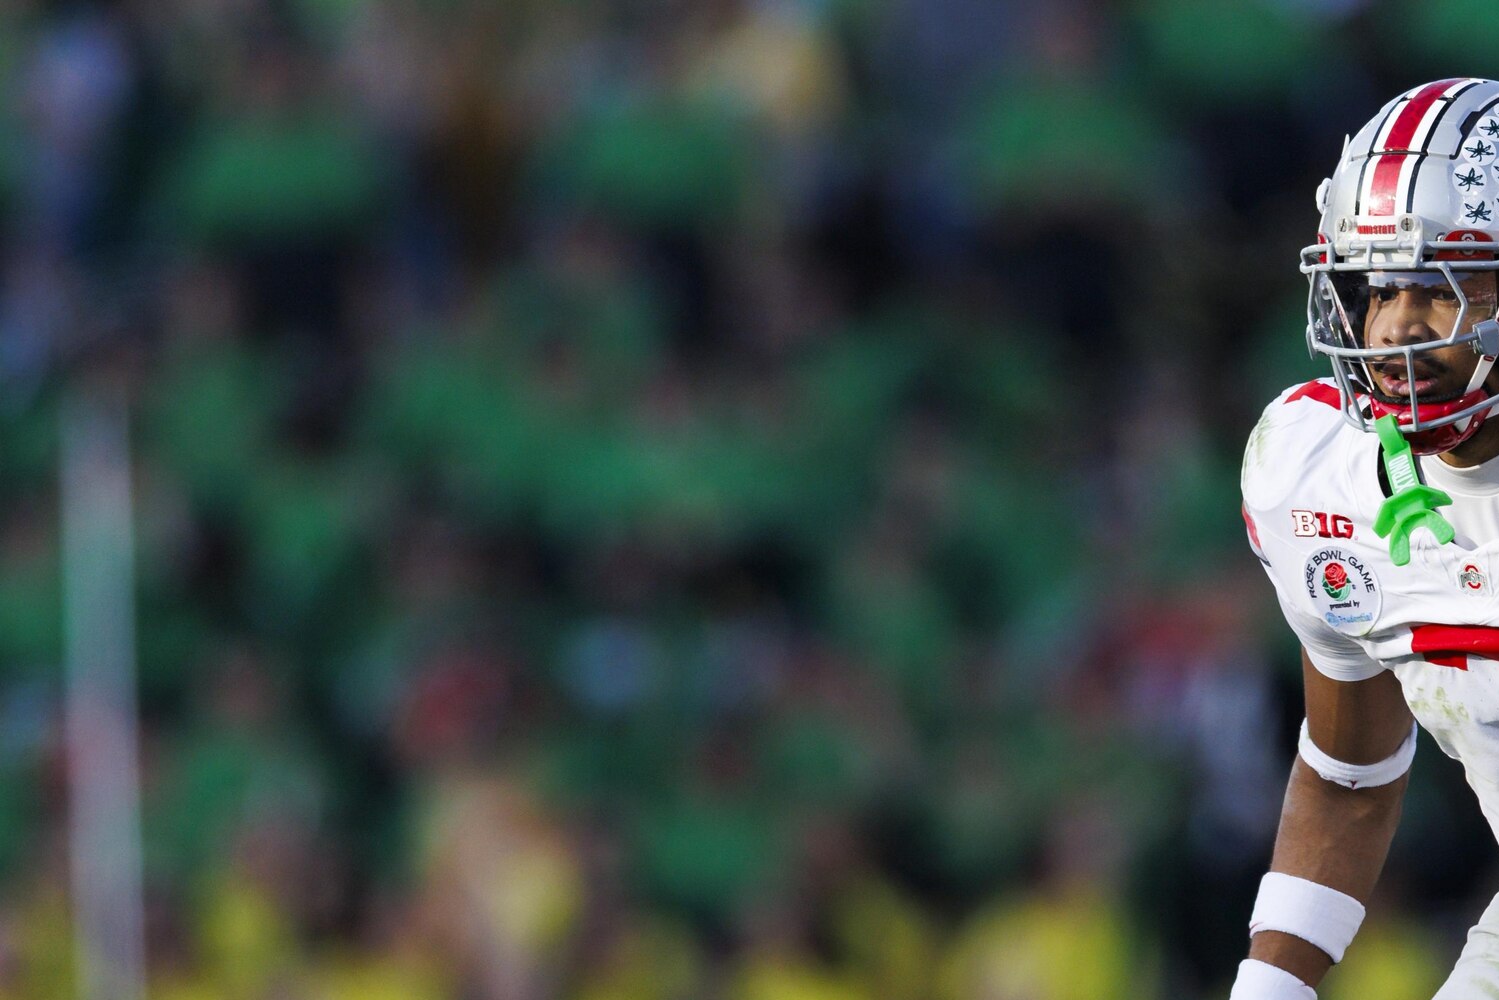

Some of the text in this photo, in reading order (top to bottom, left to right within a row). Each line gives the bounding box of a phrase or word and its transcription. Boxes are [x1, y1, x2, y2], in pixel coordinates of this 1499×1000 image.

[1306, 550, 1376, 598] ROSE BOWL GAME
[1352, 600, 1360, 608] by
